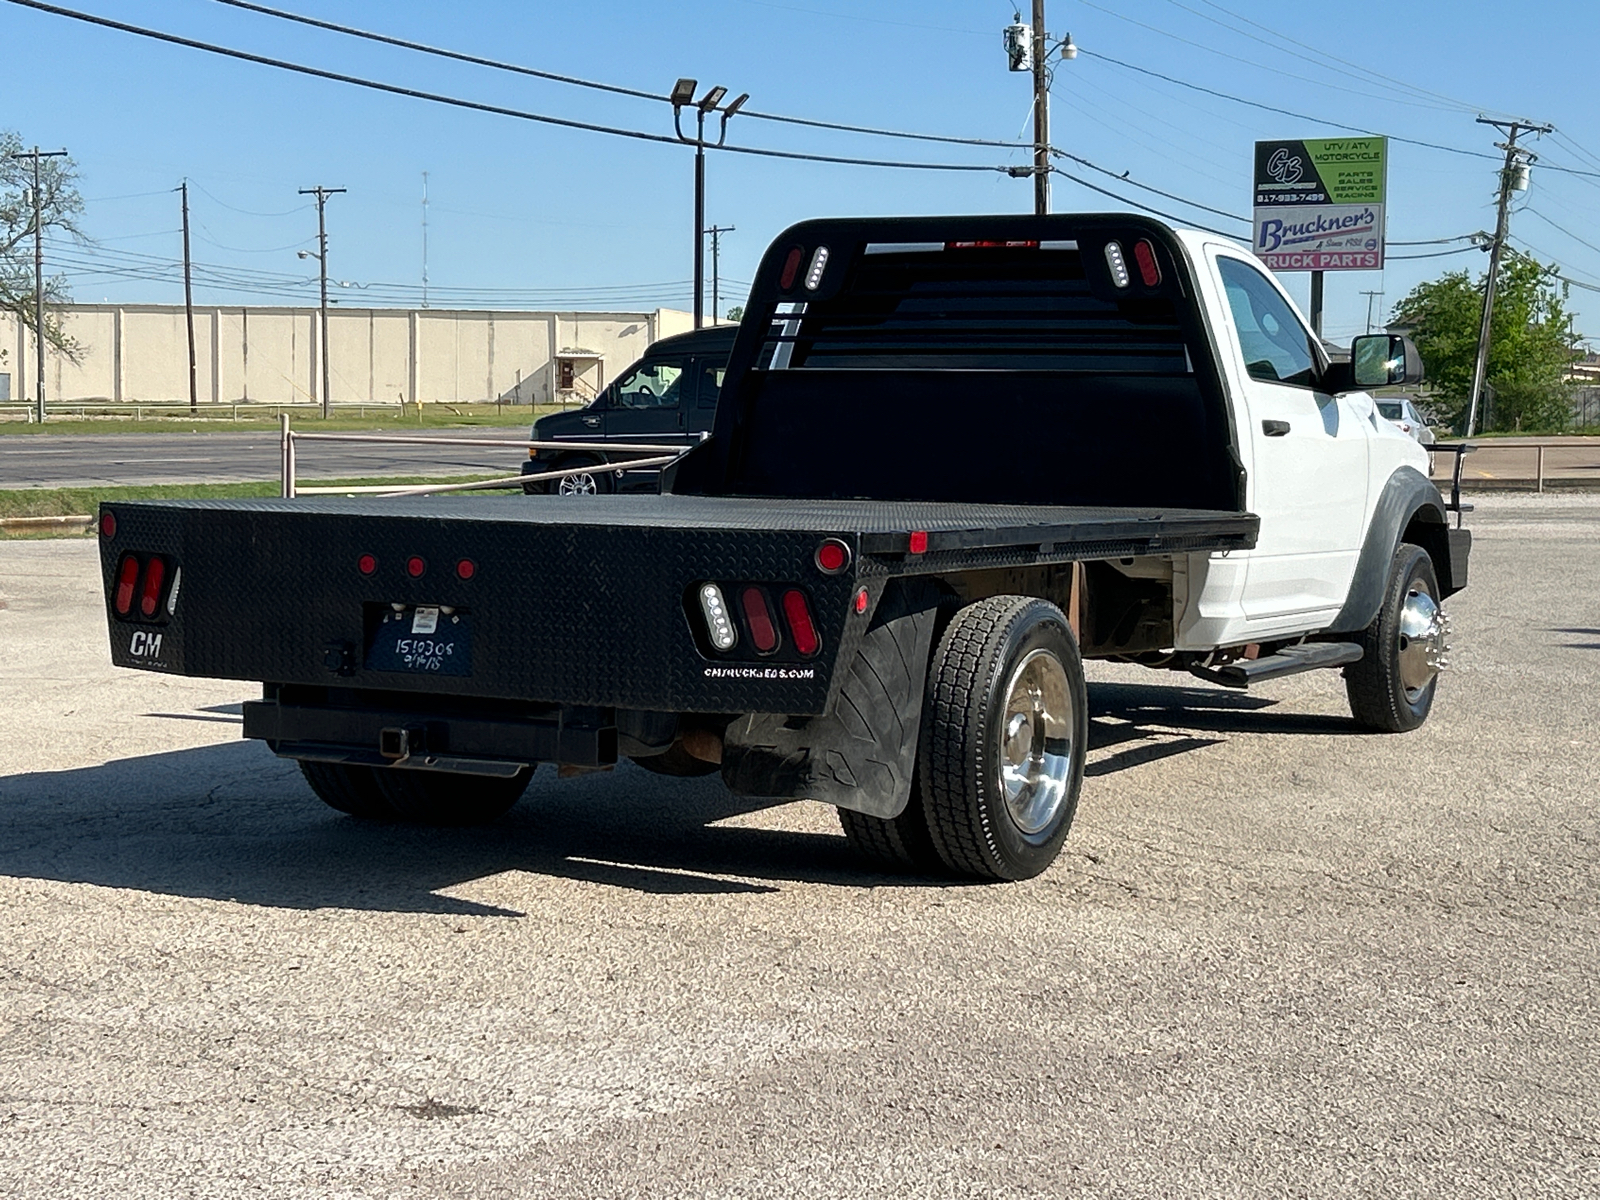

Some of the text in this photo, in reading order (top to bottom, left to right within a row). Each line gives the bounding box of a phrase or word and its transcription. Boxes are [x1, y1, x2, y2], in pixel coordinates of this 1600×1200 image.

[1315, 152, 1380, 160] MOTORCYCLE
[1259, 208, 1374, 252] Bruckner's
[1321, 254, 1375, 267] PARTS
[130, 631, 162, 658] CM
